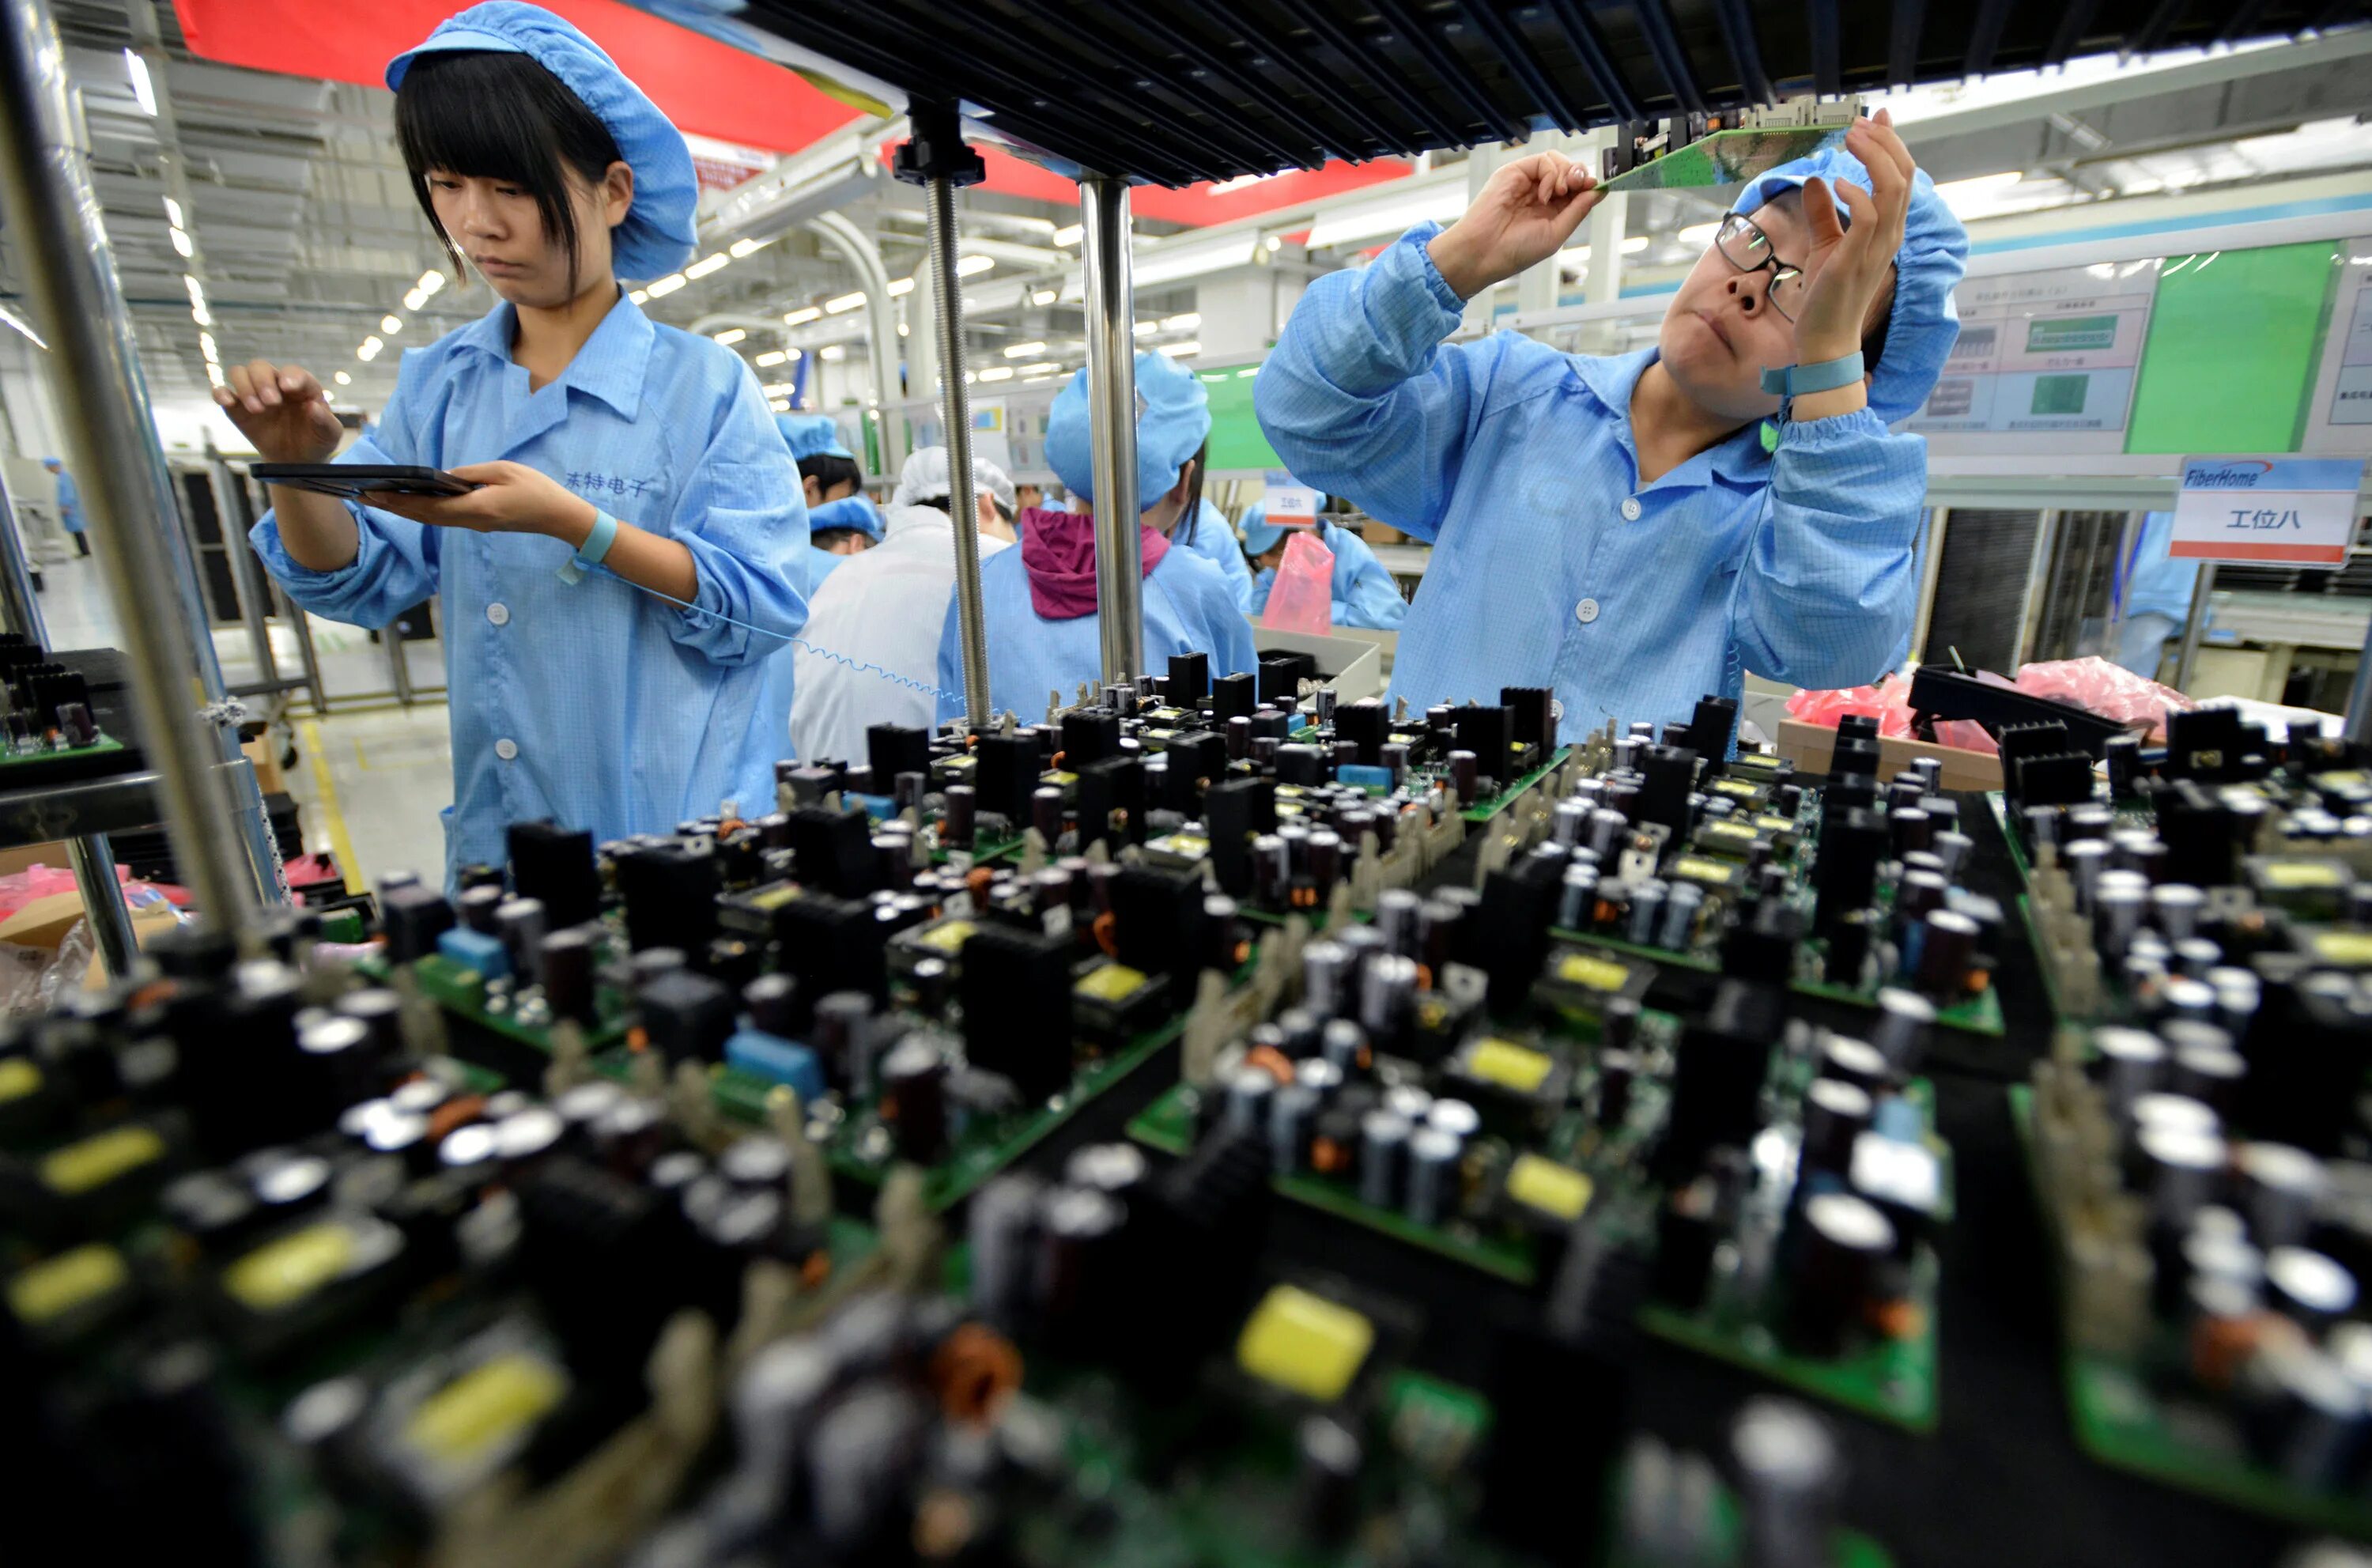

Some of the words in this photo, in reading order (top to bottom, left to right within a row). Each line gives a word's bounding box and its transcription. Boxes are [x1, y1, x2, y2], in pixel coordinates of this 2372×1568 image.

[2184, 468, 2259, 487] FiberHome
[2227, 509, 2301, 530] 工位八
